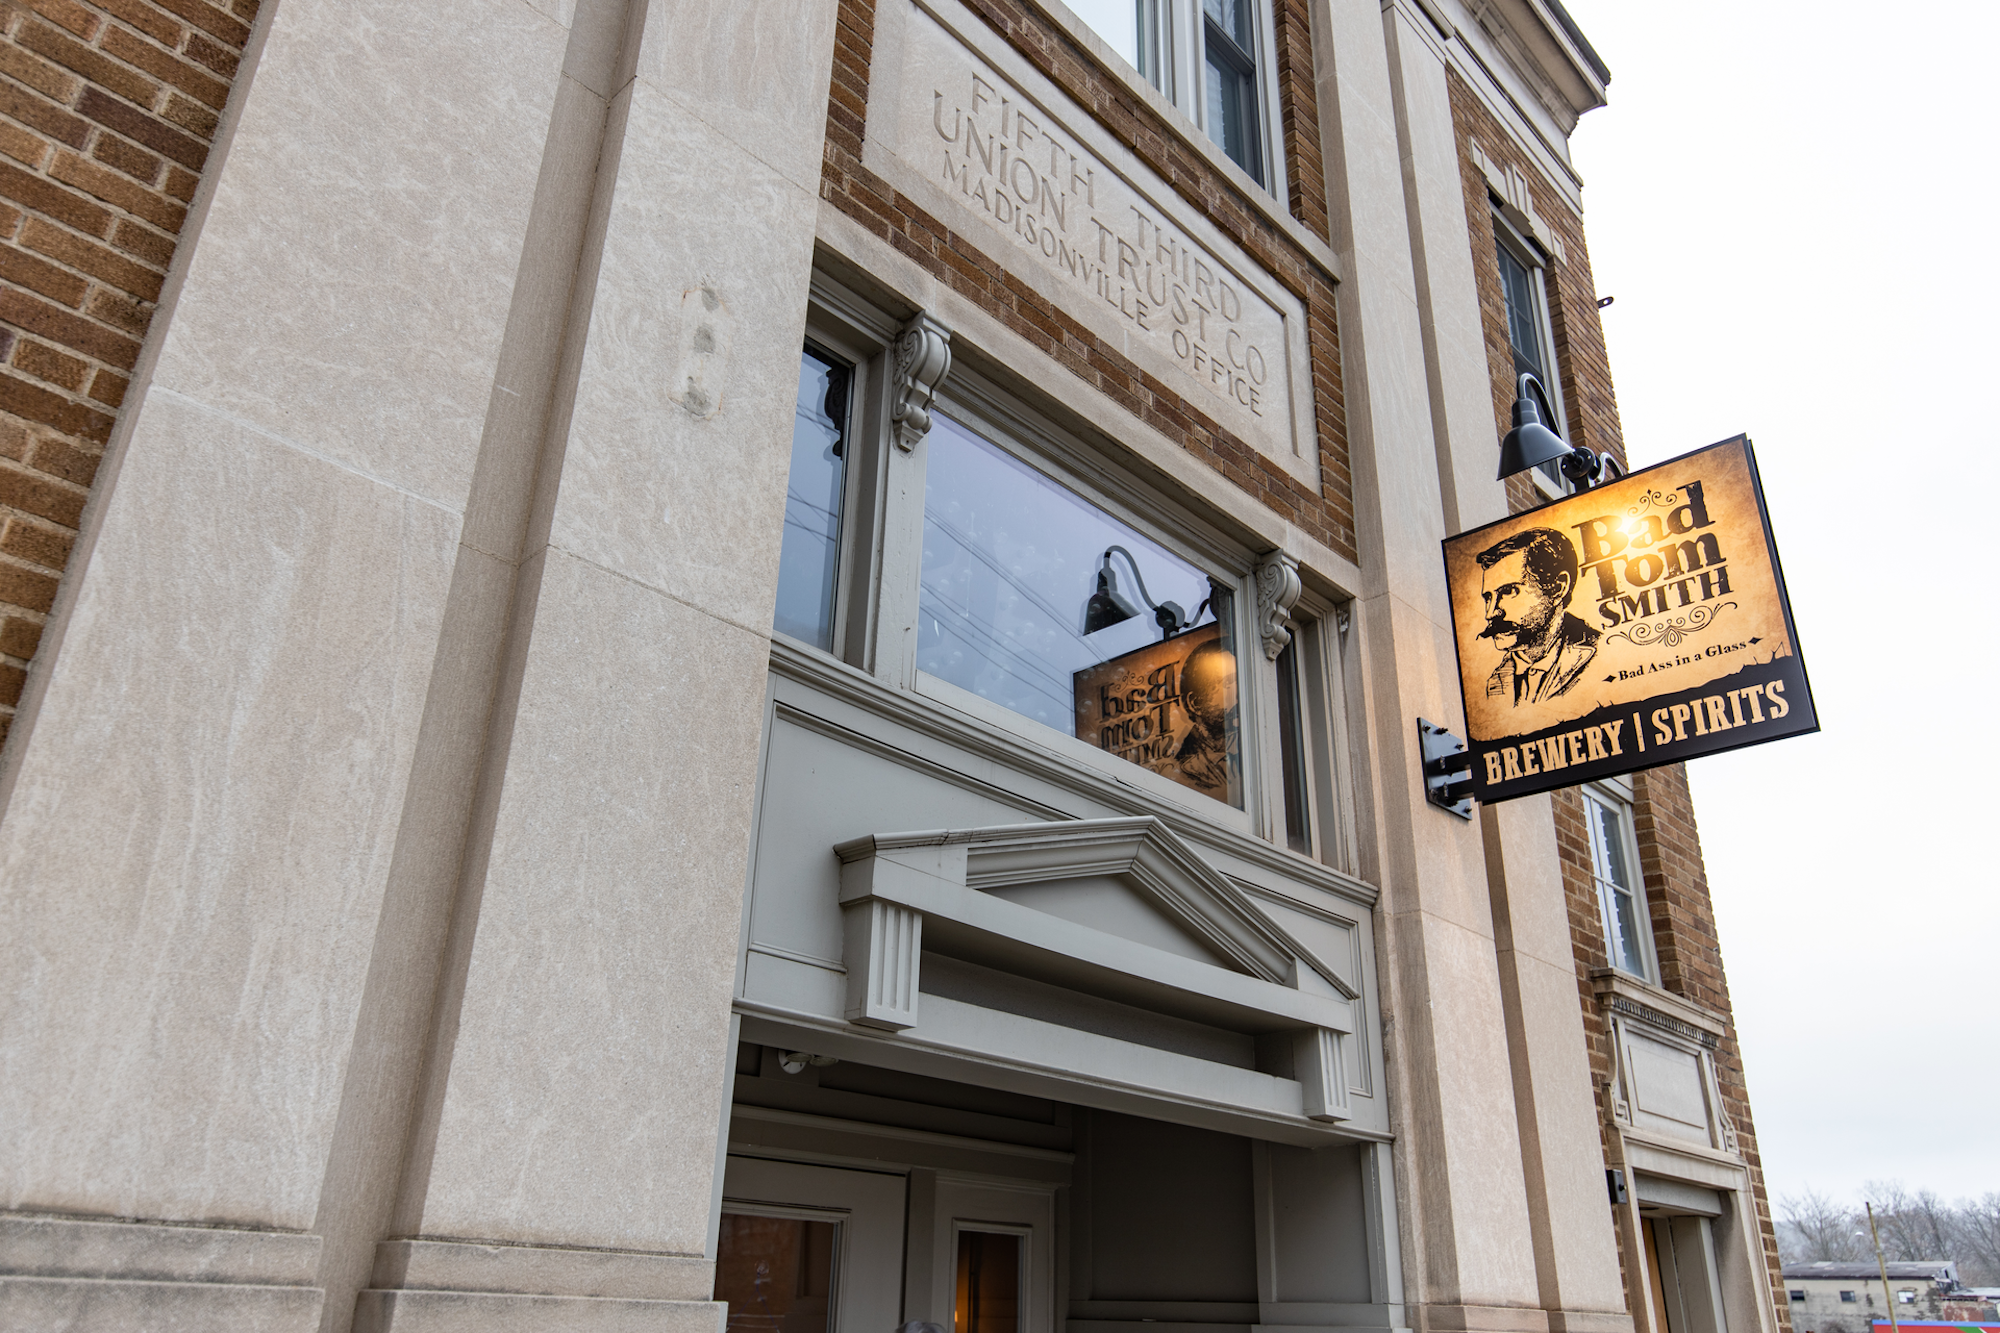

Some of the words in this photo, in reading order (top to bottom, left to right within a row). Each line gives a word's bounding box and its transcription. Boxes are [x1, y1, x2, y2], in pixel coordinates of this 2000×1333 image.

[933, 89, 1066, 232] UNION
[1090, 216, 1210, 343] TRUST
[1226, 328, 1267, 386] CO
[972, 71, 1095, 209] FIFTH
[1130, 204, 1241, 323] THIRD
[942, 149, 1151, 331] MADISONVILLE
[1172, 328, 1263, 417] OFFICE
[1571, 480, 1716, 567] Bad
[1581, 532, 1726, 602] Tom
[1598, 565, 1734, 630] SMITH
[1618, 665, 1644, 682] Bad
[1648, 660, 1673, 674] Ass
[1675, 655, 1691, 667] in
[1694, 653, 1703, 662] a
[1705, 640, 1747, 658] Glass
[1483, 719, 1625, 785] BREWERY
[1652, 680, 1790, 745] SPIRITS
